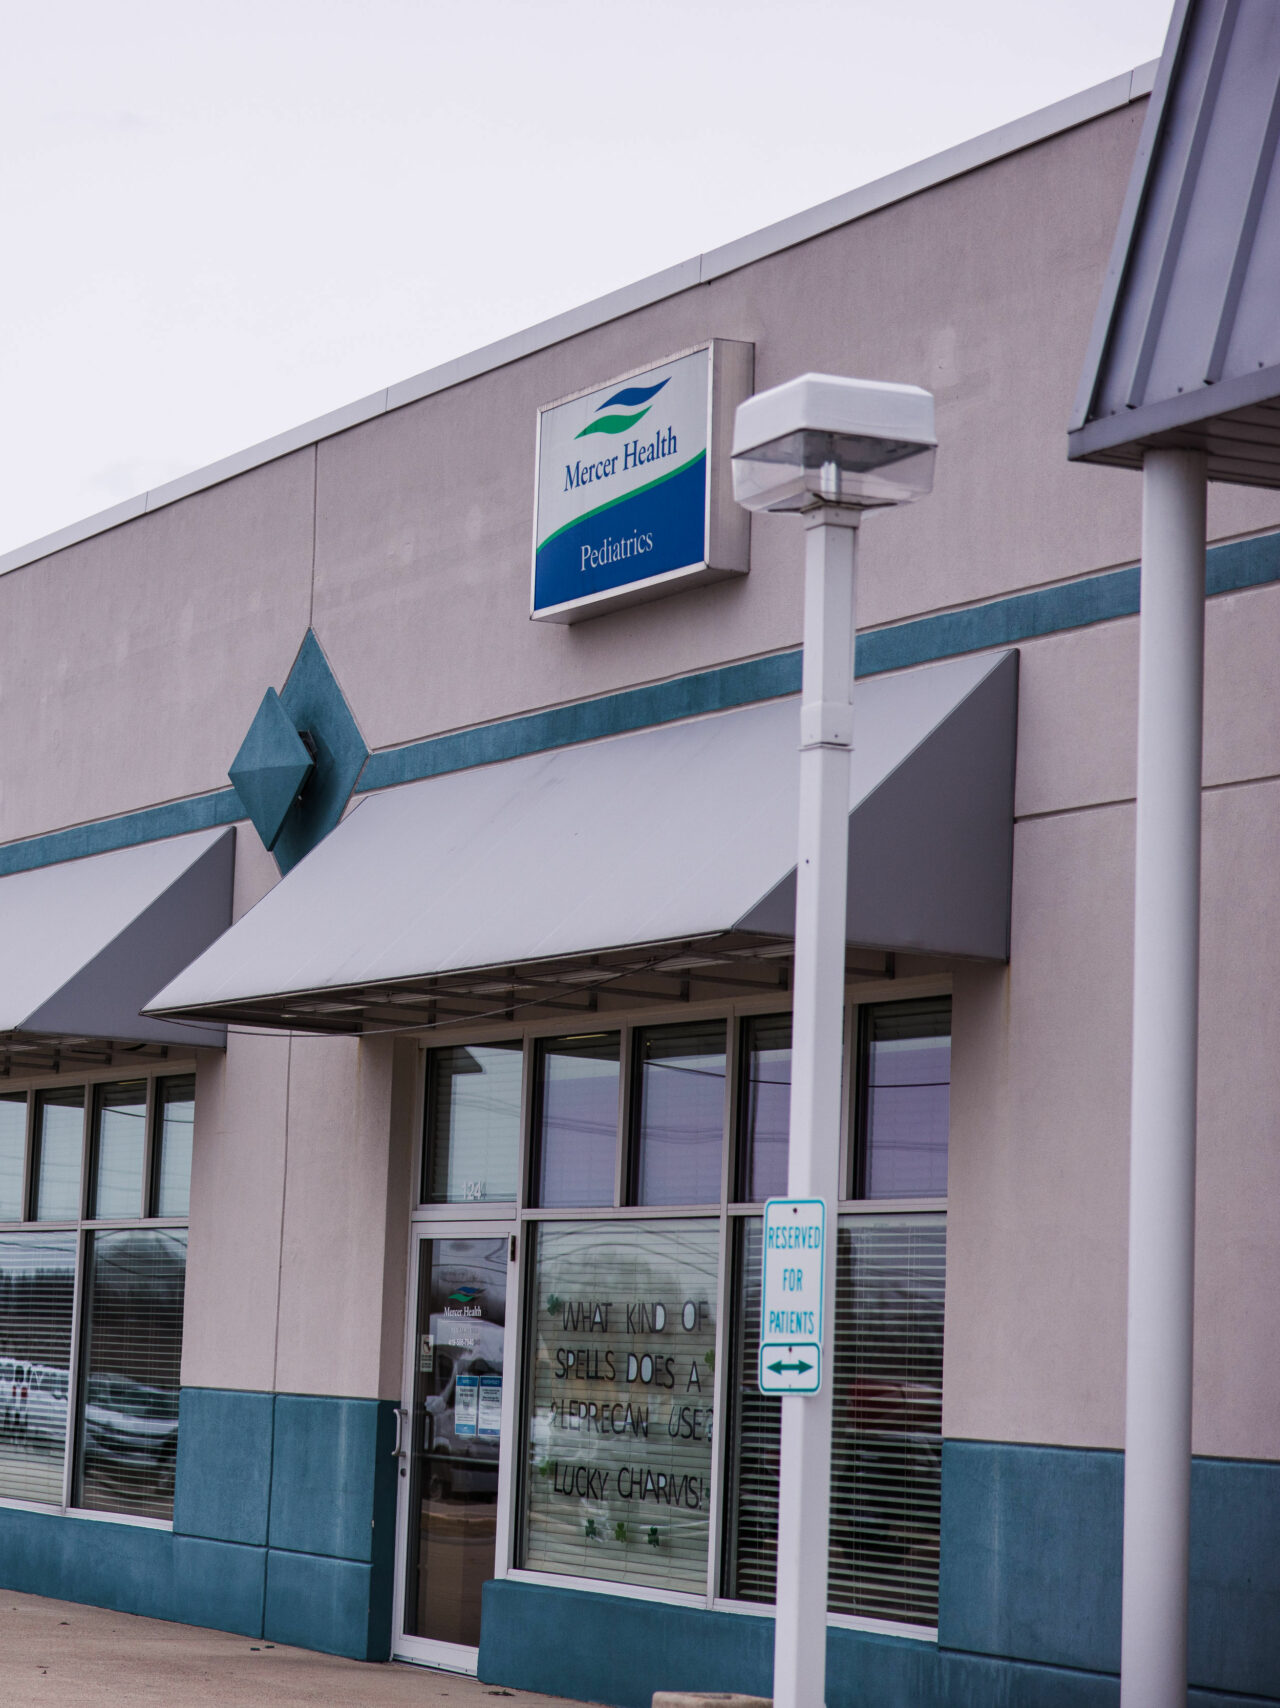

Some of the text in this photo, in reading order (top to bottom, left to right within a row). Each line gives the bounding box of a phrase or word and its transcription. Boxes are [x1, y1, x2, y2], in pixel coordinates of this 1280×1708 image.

[563, 426, 678, 492] Mercer Health
[580, 529, 653, 571] Pediatrics
[462, 1180, 481, 1200] 124
[768, 1226, 820, 1249] RESERVED
[782, 1268, 803, 1291] FOR
[443, 1305, 482, 1317] Mercer Health
[563, 1300, 709, 1334] WHAT KIND OF
[769, 1311, 814, 1335] PATIENTS
[555, 1348, 701, 1392] SPELLS DOES A
[553, 1462, 609, 1501] LUCKY
